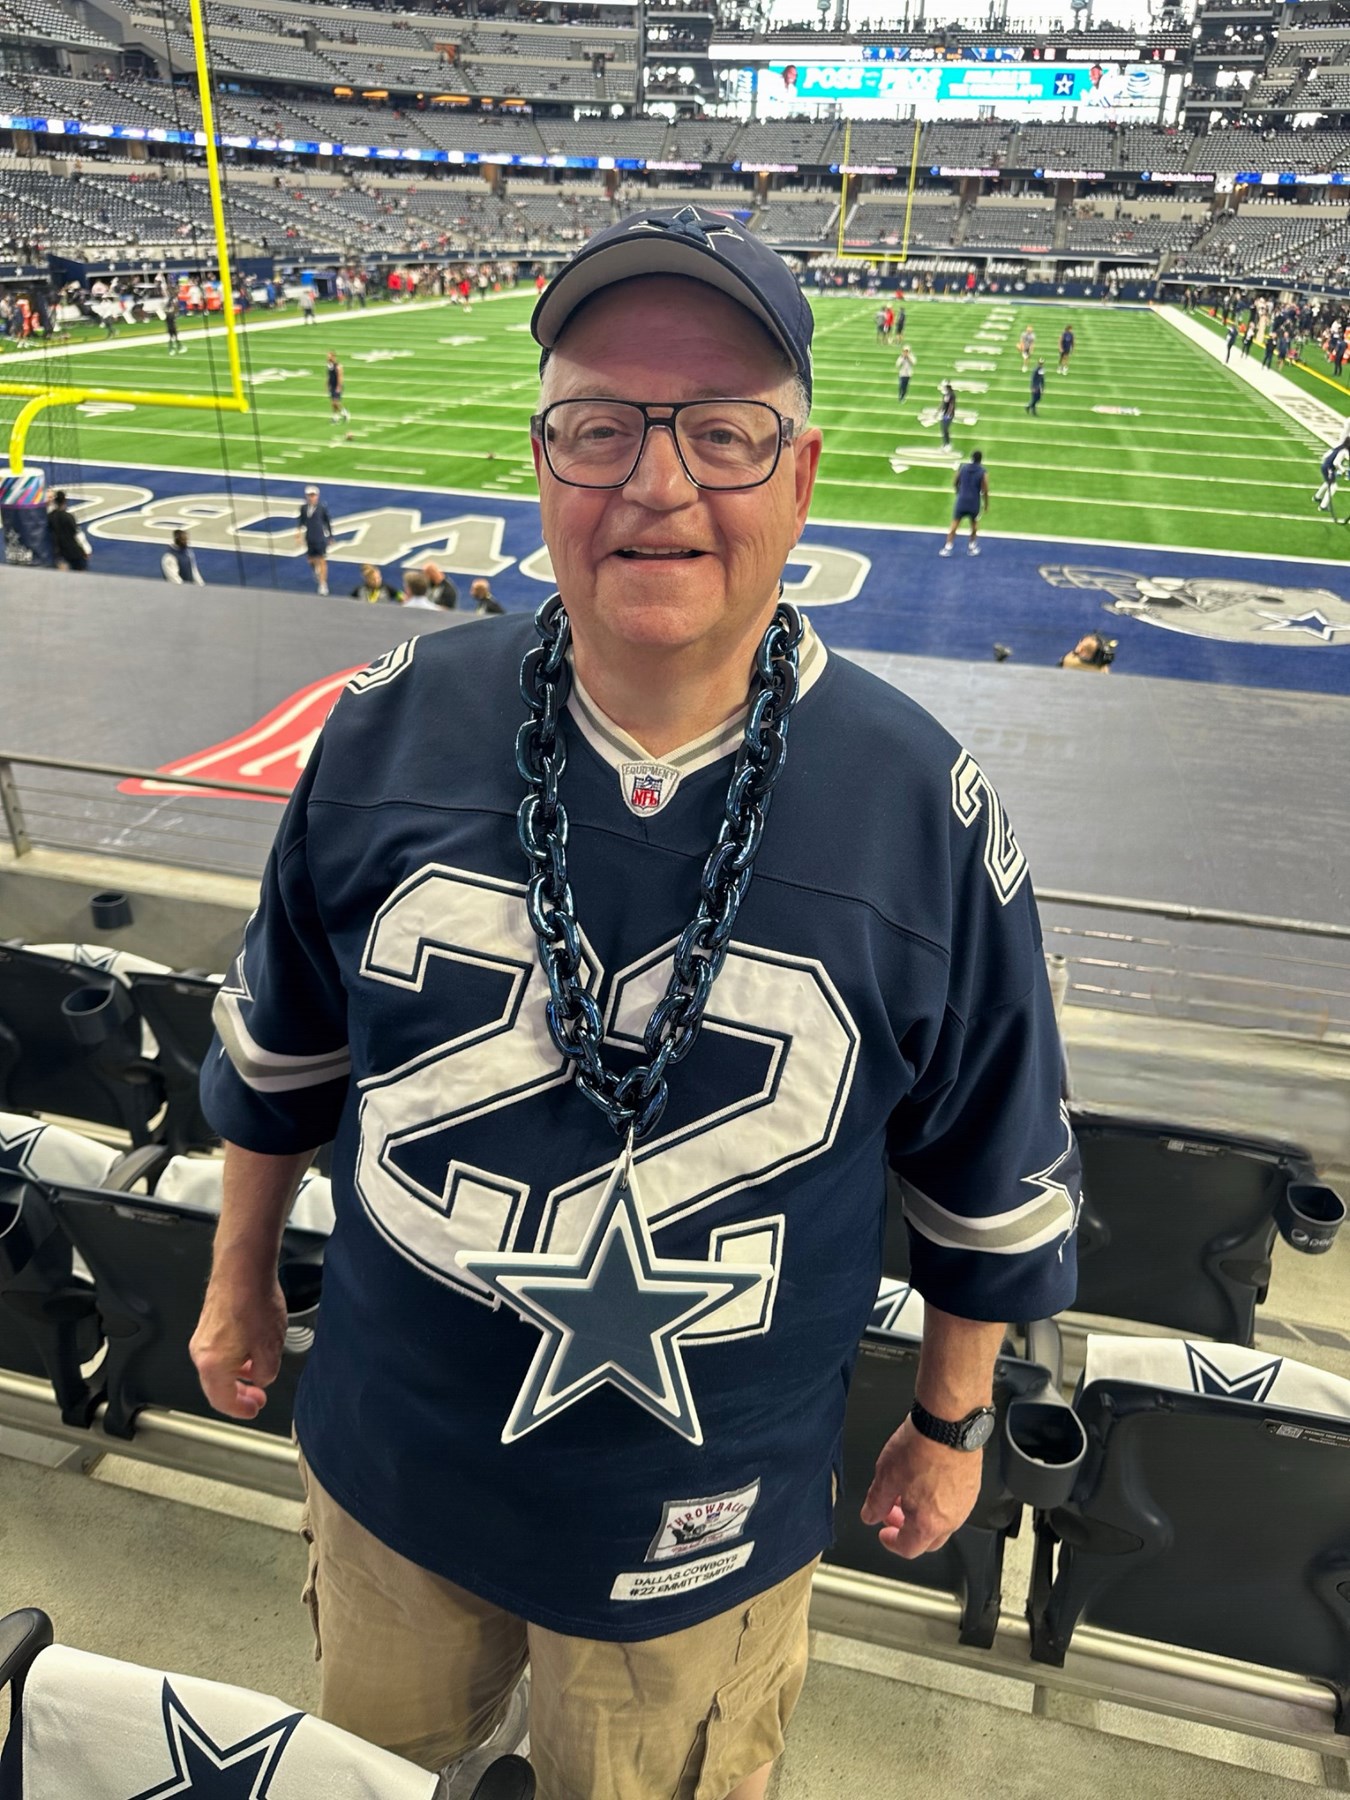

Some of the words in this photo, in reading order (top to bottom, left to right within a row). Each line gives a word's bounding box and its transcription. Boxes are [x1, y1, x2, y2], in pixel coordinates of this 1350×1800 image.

[624, 764, 676, 781] EQUIPMENT
[633, 788, 658, 807] NFL
[354, 861, 862, 1346] 22
[629, 1586, 654, 1597] #22
[657, 1574, 702, 1593] EMMITT
[702, 1563, 735, 1581] SMITH
[634, 1571, 681, 1586] DALLAS
[682, 1554, 738, 1577] COWBOYS
